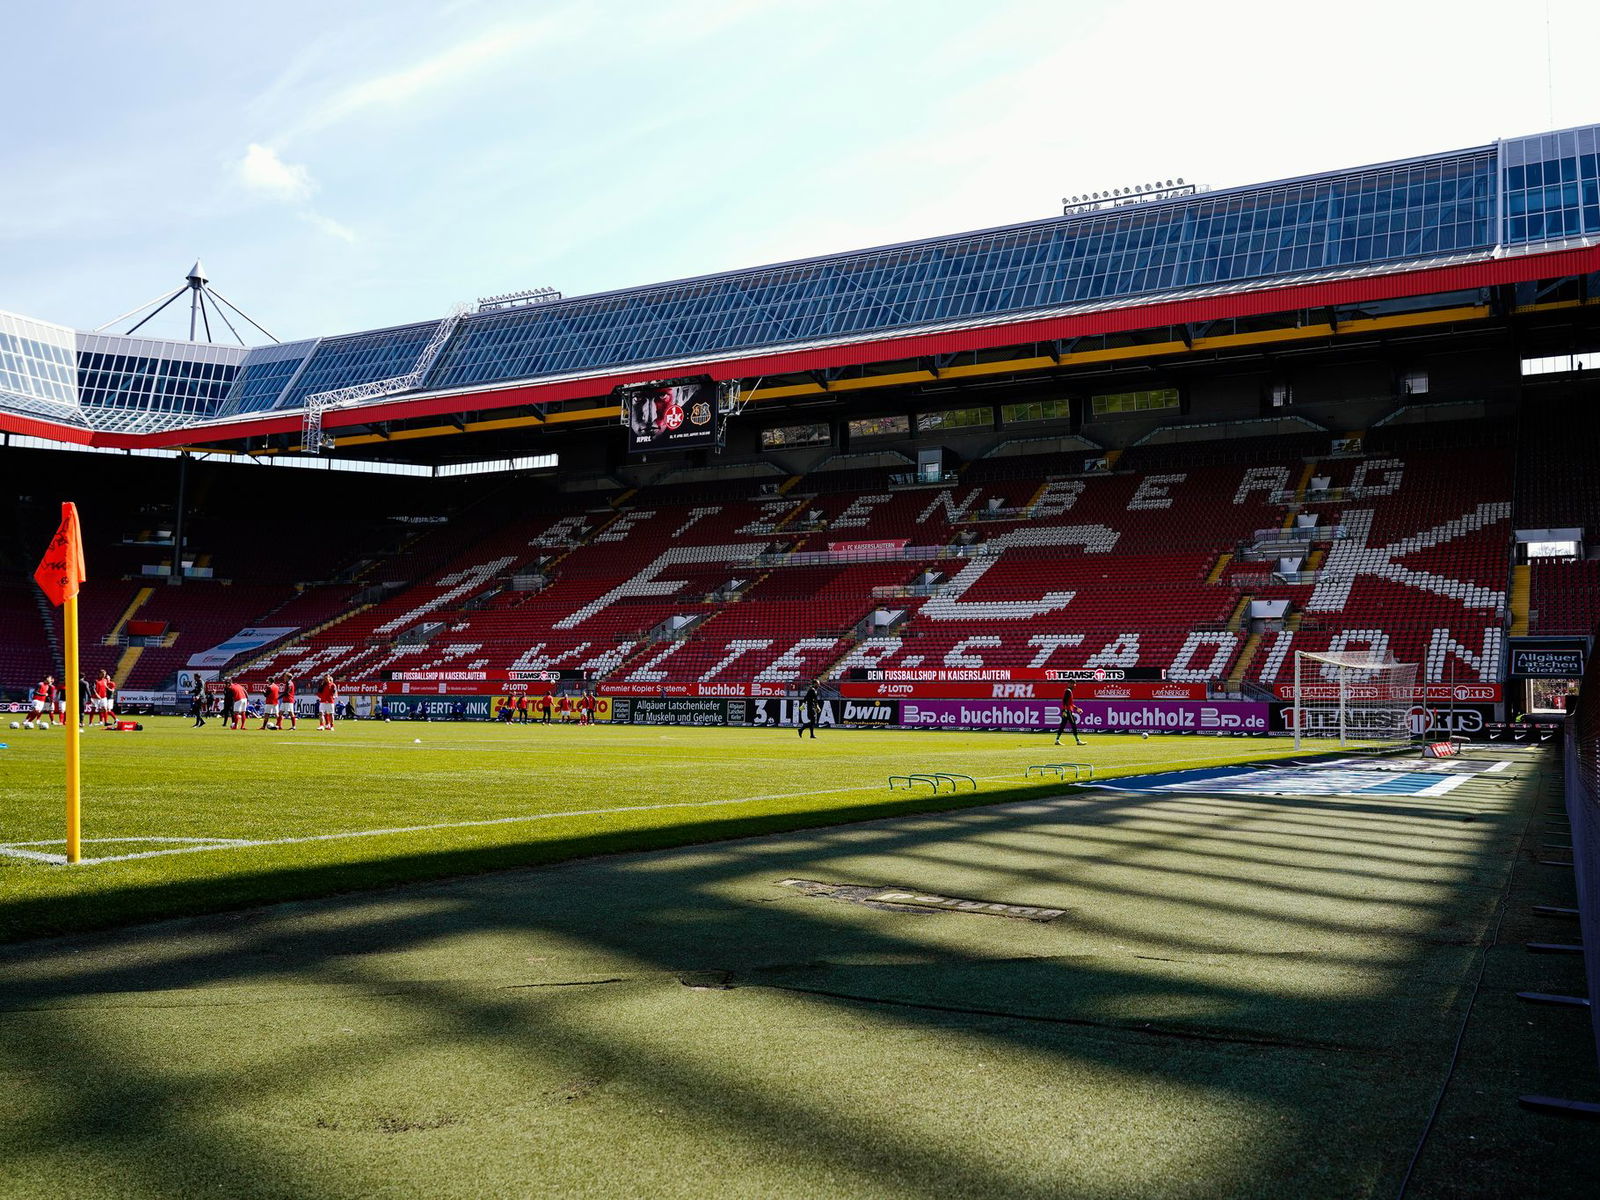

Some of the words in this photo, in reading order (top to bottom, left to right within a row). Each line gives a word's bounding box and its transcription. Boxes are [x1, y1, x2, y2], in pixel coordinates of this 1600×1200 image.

[1518, 653, 1577, 662] Allgäuer
[403, 672, 438, 680] FUSSBALLSHOP
[445, 672, 486, 680] KAISERSLAUTERN
[867, 671, 884, 680] DEIN
[885, 671, 937, 680] FUSSBALLSHOP
[938, 671, 947, 680] IN
[947, 671, 1011, 680] KAISERSLAUTERN
[361, 684, 378, 692] Forst
[698, 684, 745, 696] buchholz
[888, 685, 914, 693] LOTTO
[992, 684, 1036, 698] RPR1.
[636, 701, 667, 711] Allgäuer
[668, 701, 720, 711] Latschenkiefer
[843, 700, 892, 720] bwin
[634, 712, 645, 722] für
[646, 713, 676, 722] Muskeln
[677, 713, 690, 722] und
[693, 713, 723, 723] Gelenke
[961, 706, 1040, 724] buchholz
[1044, 706, 1102, 725] BD.de
[1107, 707, 1195, 726] buchholz
